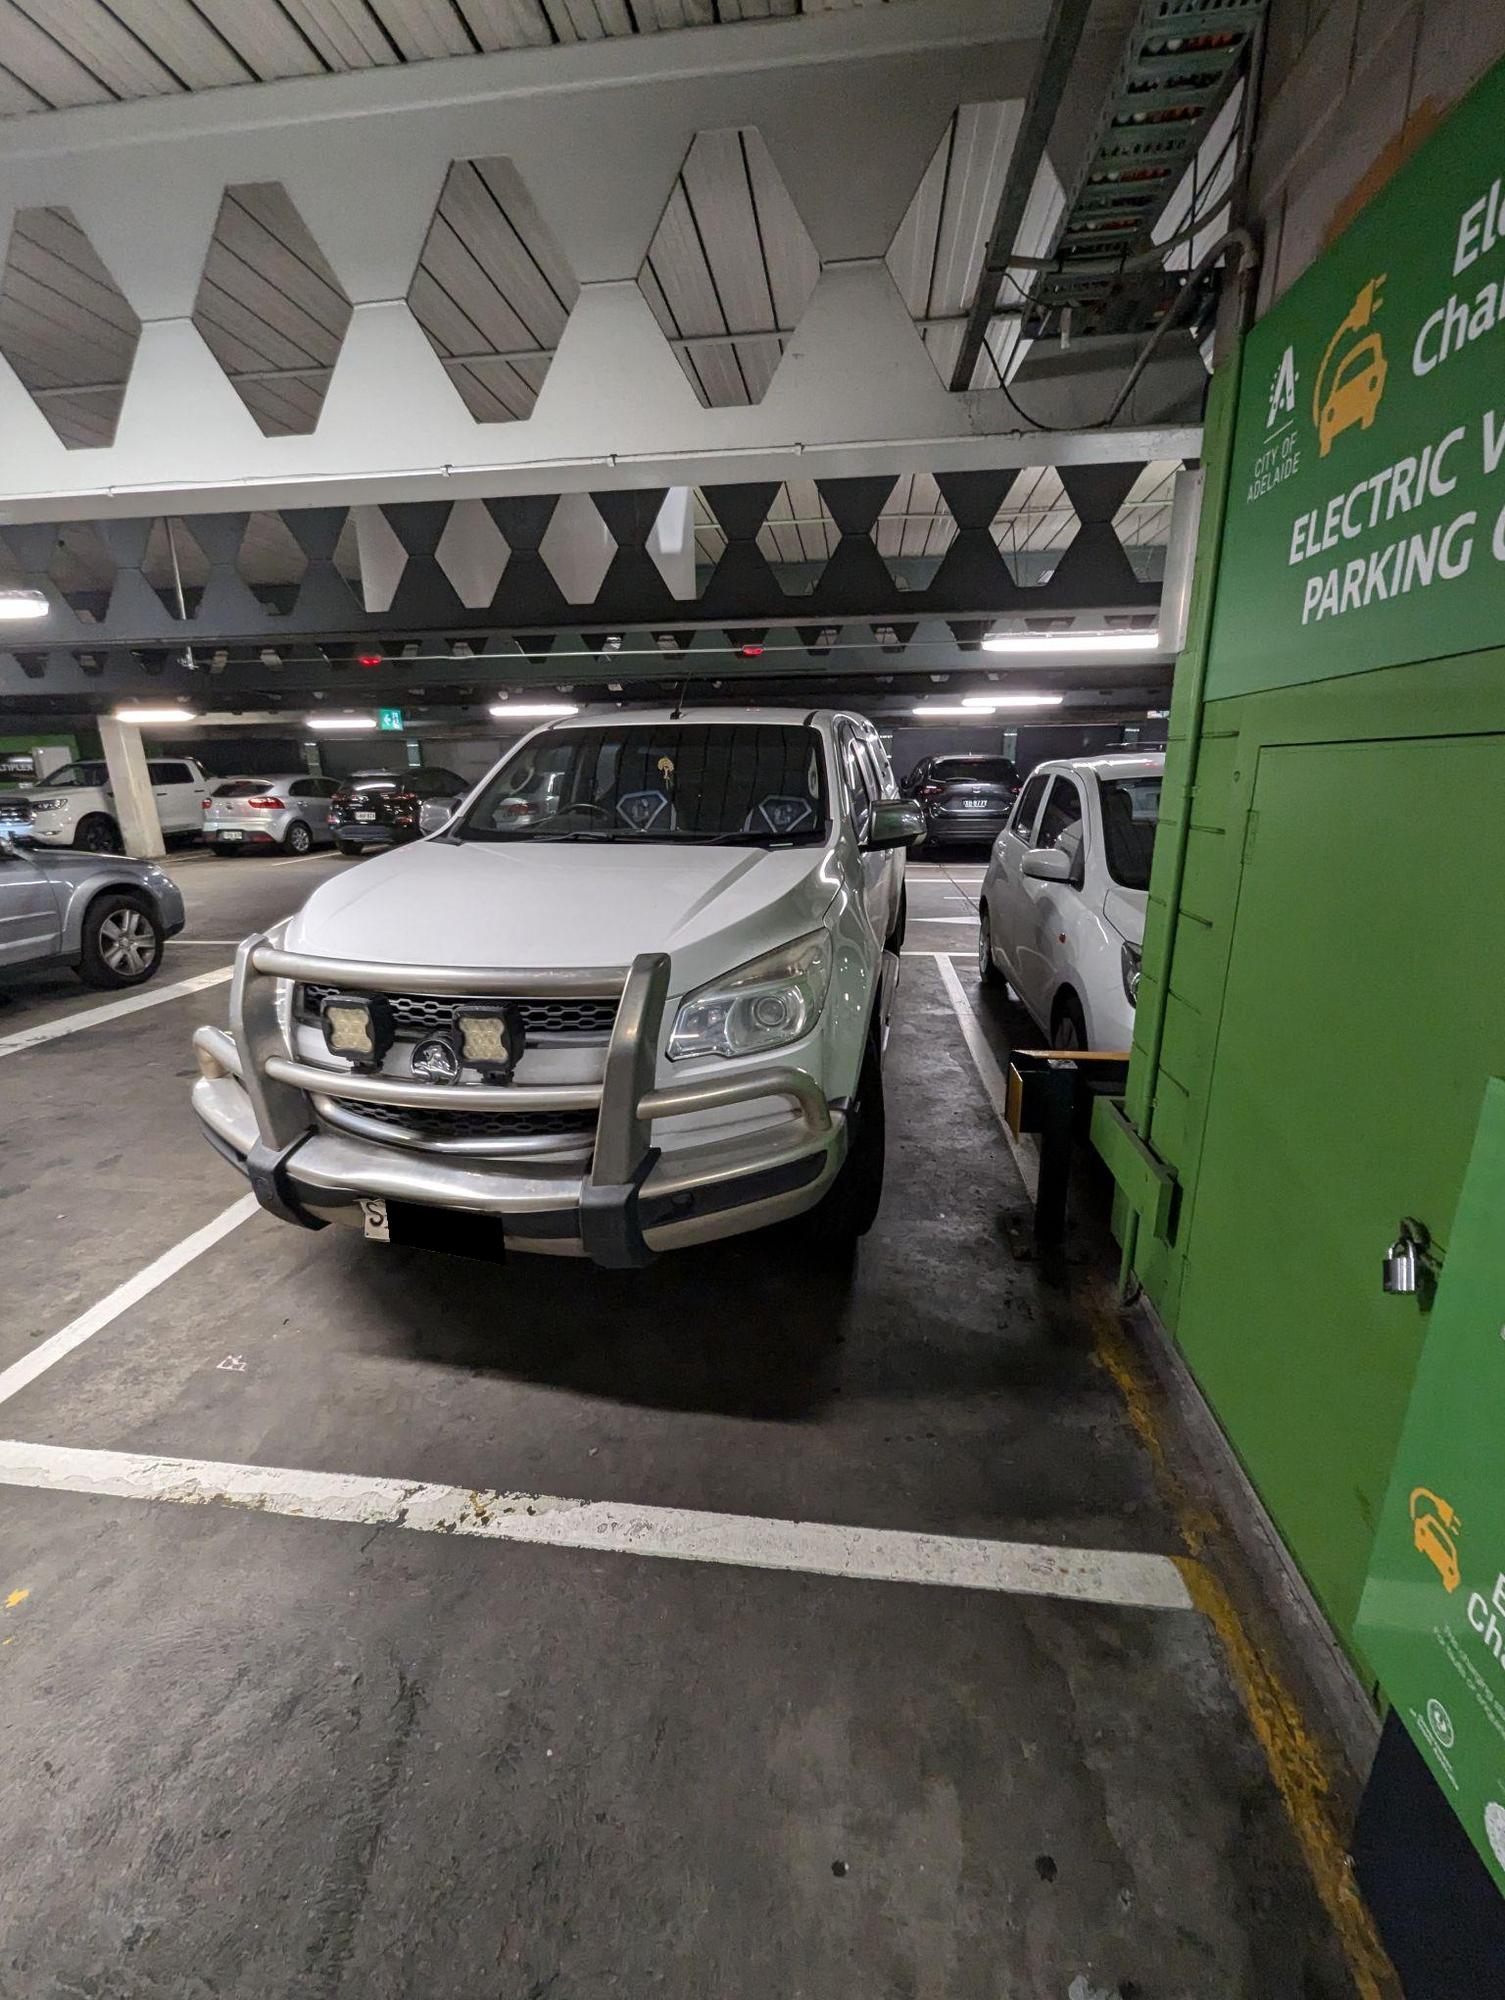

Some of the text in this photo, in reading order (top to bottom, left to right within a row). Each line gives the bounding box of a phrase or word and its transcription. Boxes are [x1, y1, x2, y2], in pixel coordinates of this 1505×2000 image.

[1247, 452, 1301, 503] ADELAIDE
[1255, 431, 1298, 478] CITY OF
[1289, 426, 1465, 566] ELECTRIC
[1302, 511, 1477, 625] PARKING
